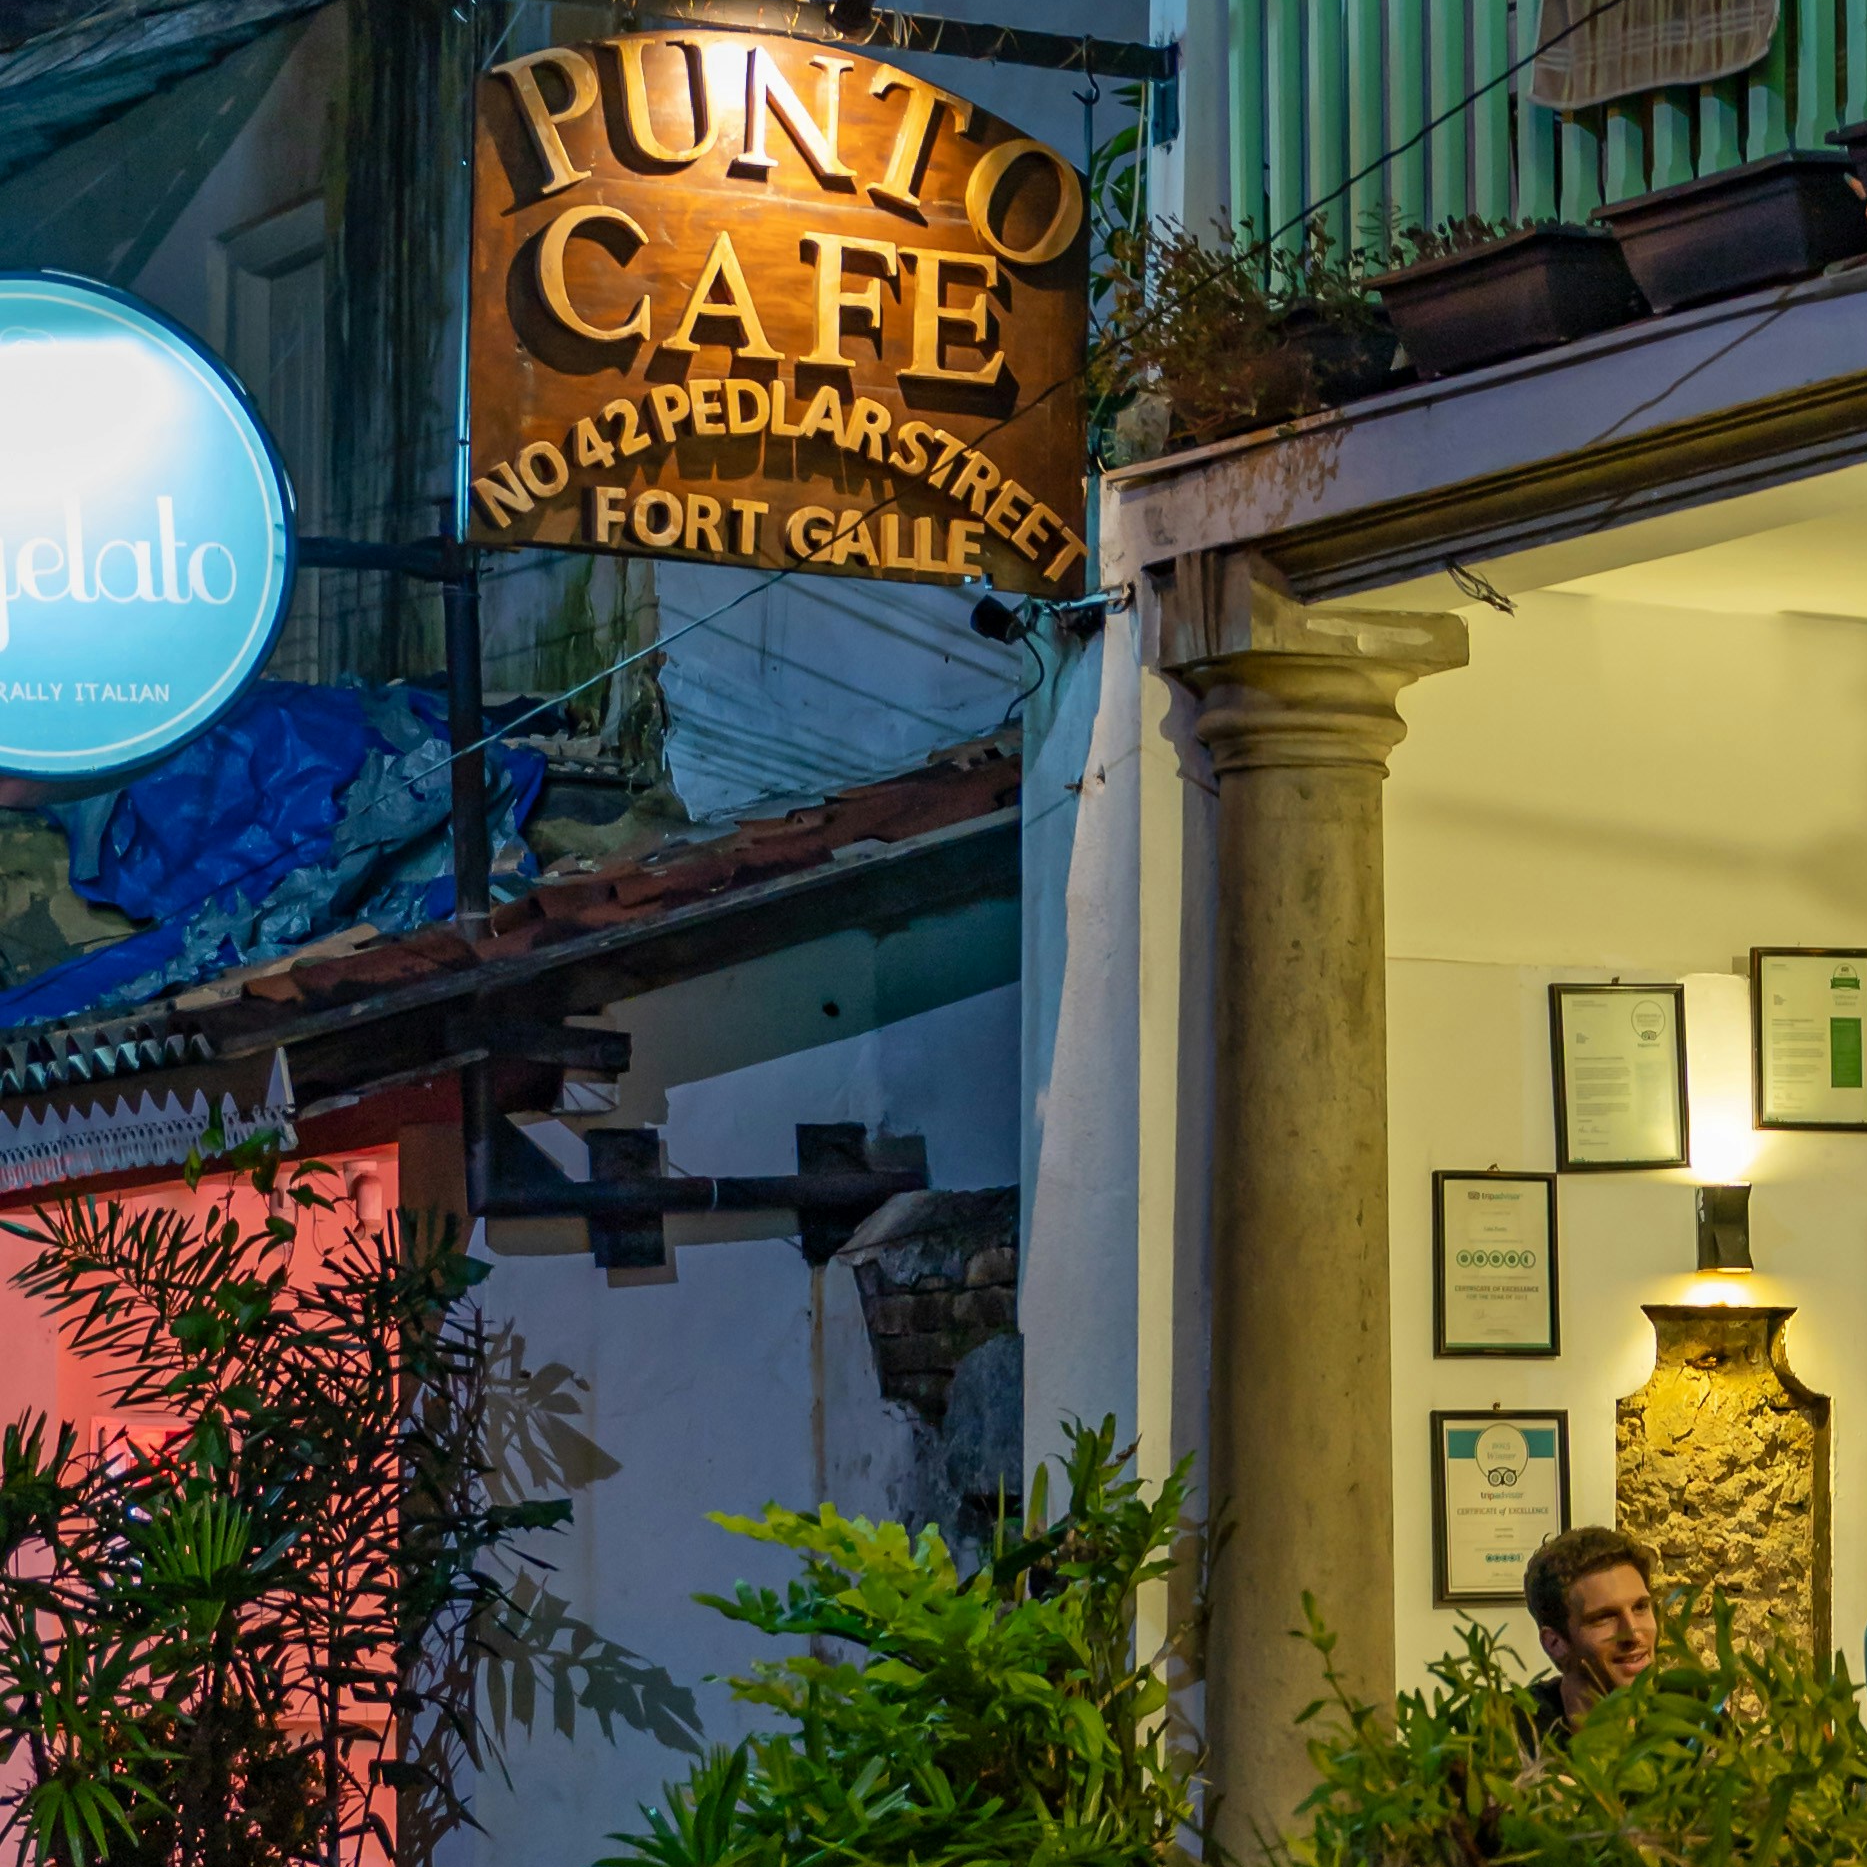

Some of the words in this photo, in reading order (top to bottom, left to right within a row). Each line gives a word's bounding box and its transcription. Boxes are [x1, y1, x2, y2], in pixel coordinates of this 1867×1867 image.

[491, 39, 1083, 264] PUNTO
[535, 205, 1005, 384] CAFE
[473, 440, 570, 529] NO
[571, 397, 651, 469] 42
[651, 379, 893, 464] PEDLAR
[889, 421, 1088, 583] STREET
[596, 486, 768, 556] FORT
[785, 506, 987, 575] GALLE
[75, 682, 169, 704] ITALIAN
